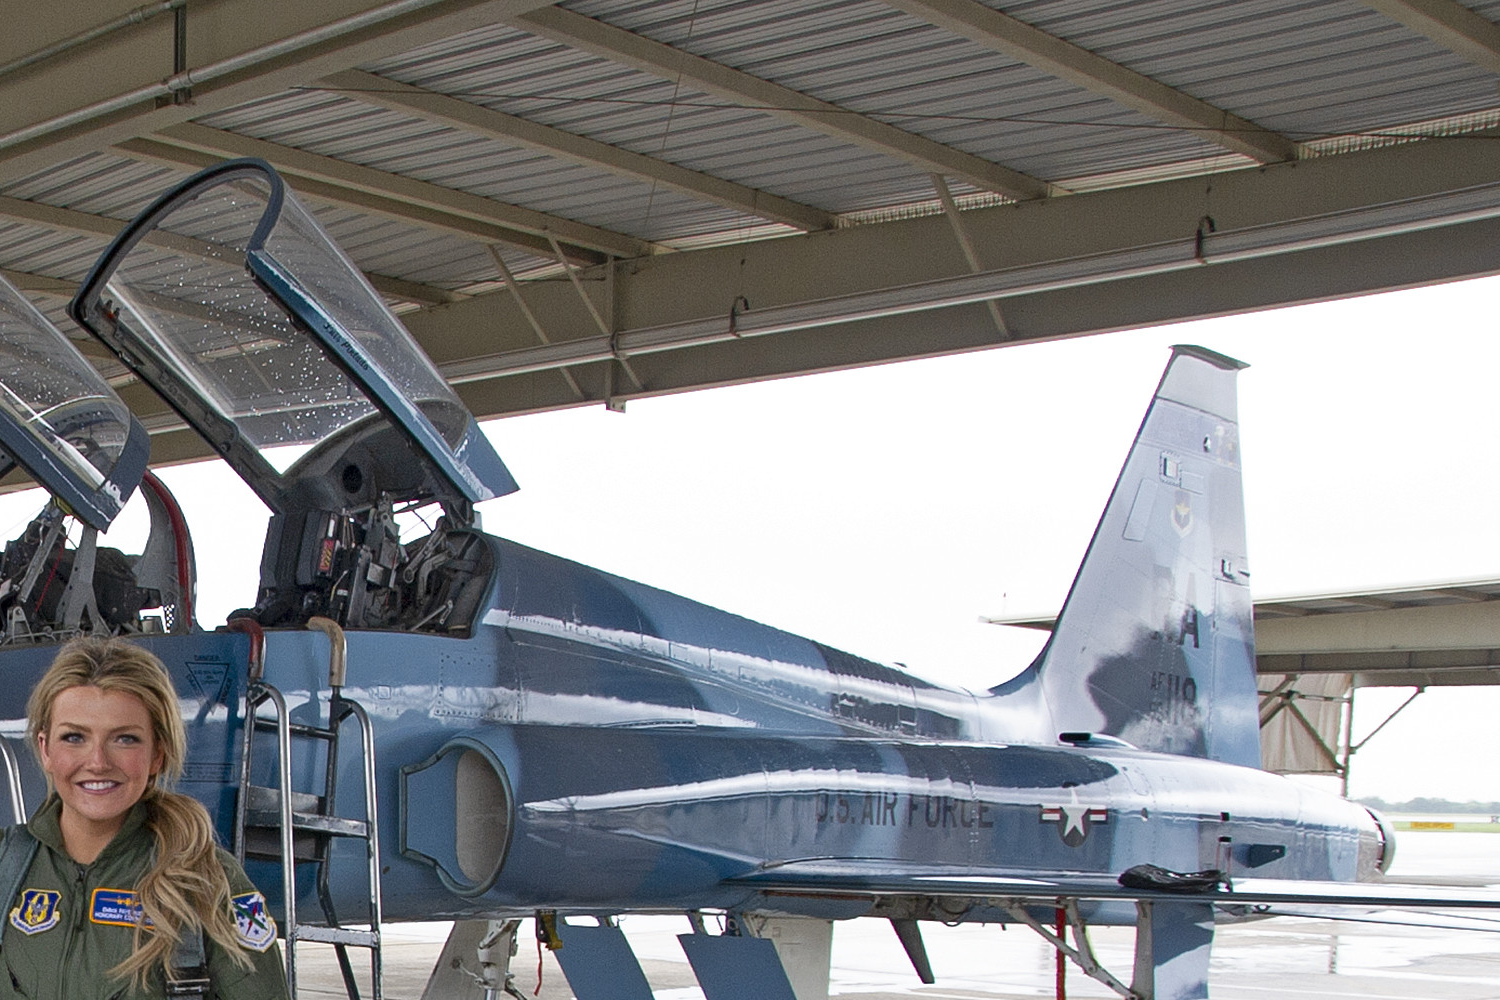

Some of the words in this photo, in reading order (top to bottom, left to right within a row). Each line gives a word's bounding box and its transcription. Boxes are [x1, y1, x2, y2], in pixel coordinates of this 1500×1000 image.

[815, 793, 855, 825] U.S.
[861, 791, 897, 827] AIR
[908, 793, 995, 829] FORCE
